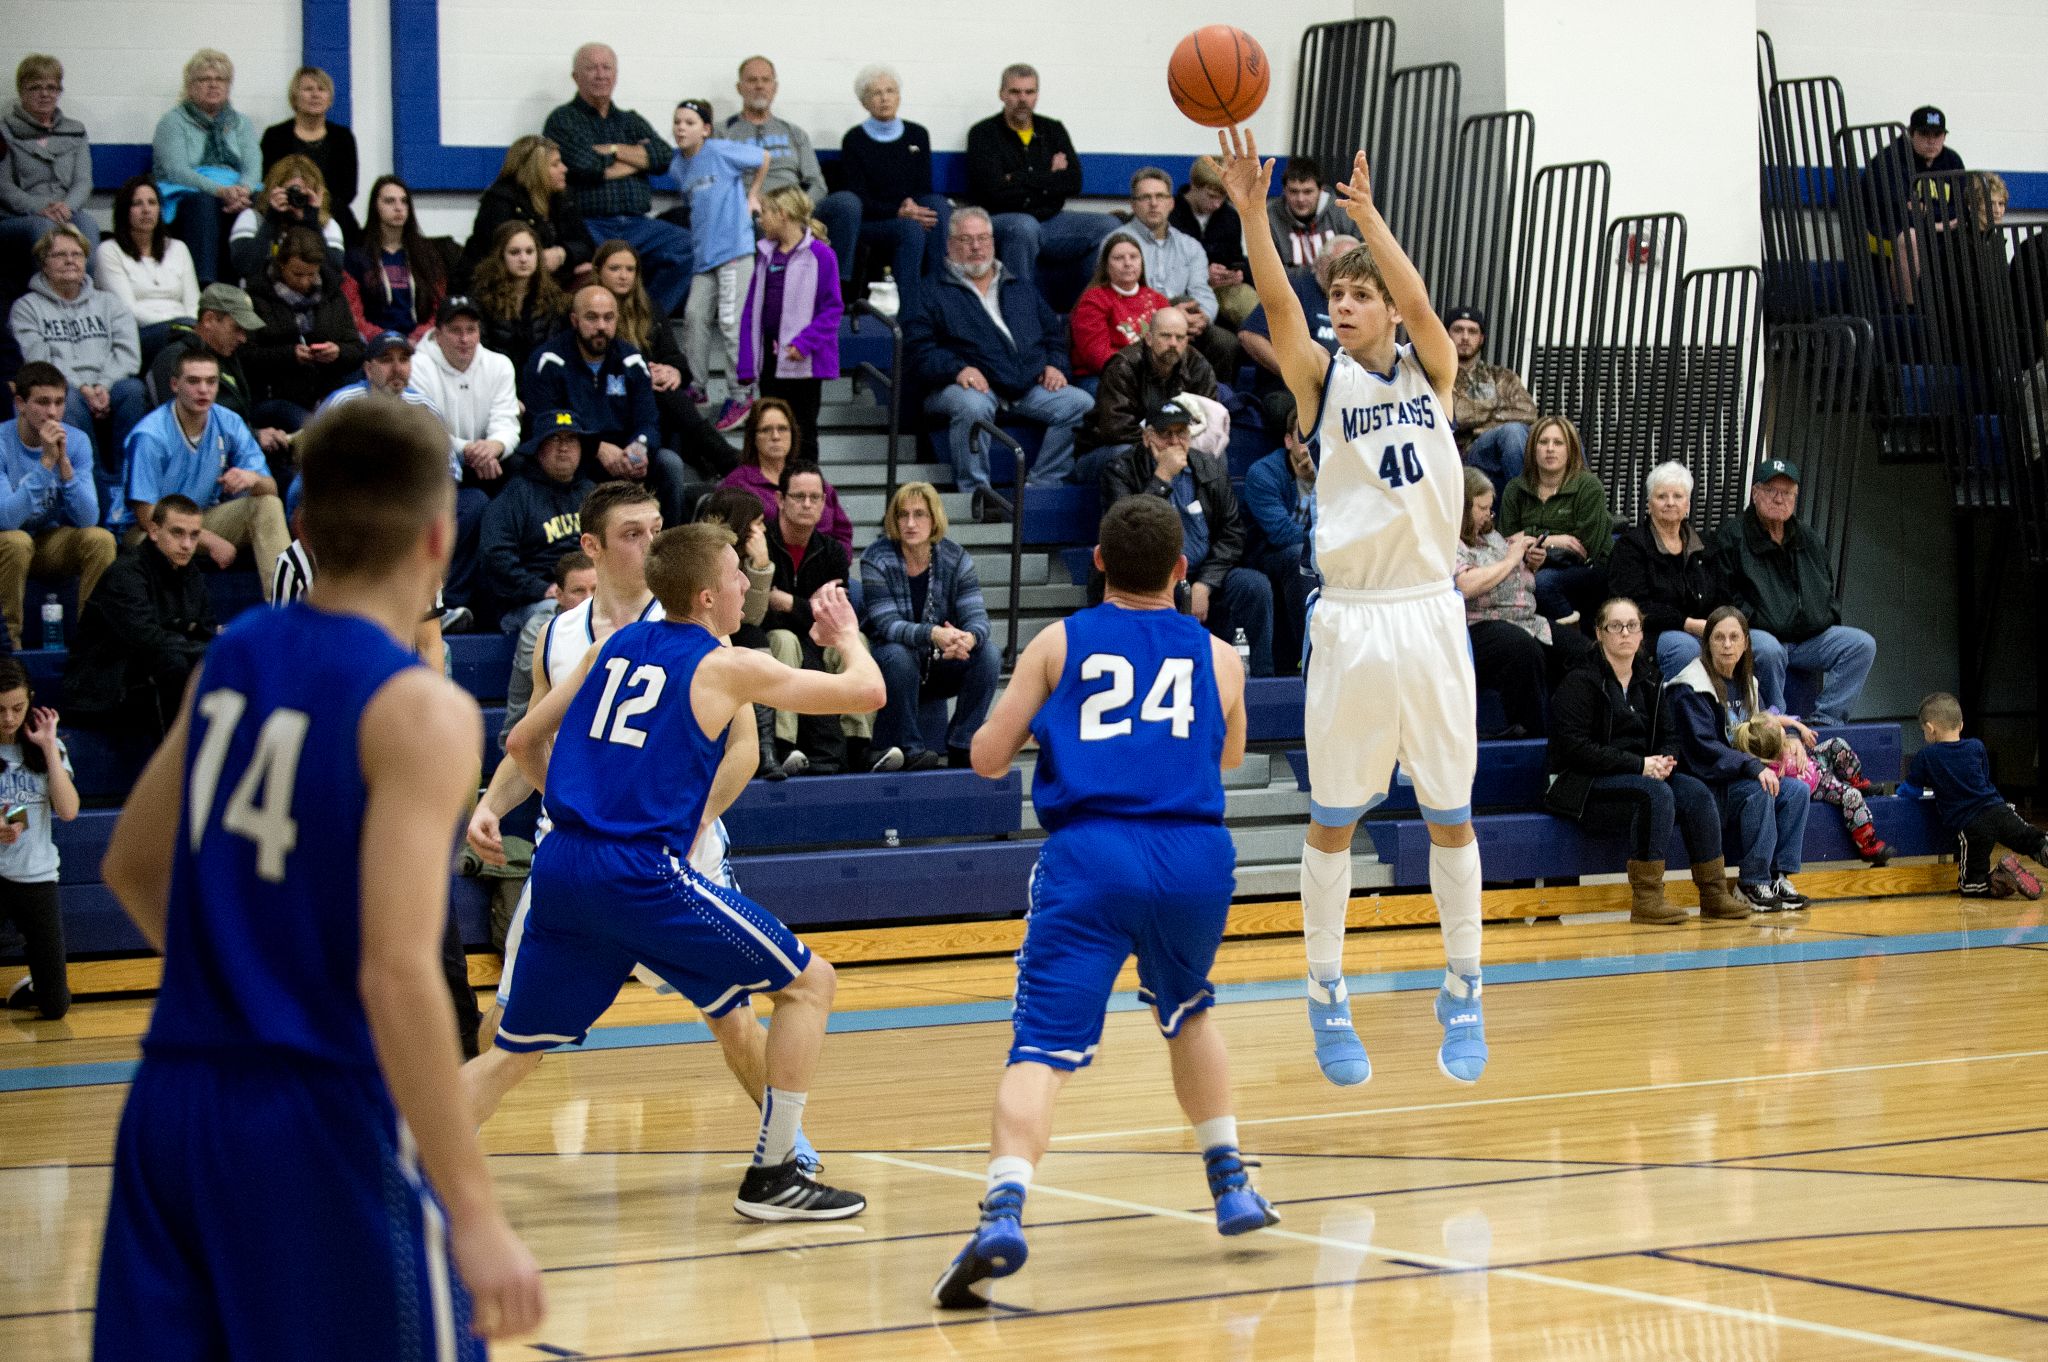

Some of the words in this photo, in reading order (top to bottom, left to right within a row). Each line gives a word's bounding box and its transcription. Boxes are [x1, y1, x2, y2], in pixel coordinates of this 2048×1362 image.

[606, 374, 627, 396] M
[1379, 442, 1424, 488] 40
[589, 657, 667, 748] 12
[1080, 653, 1195, 741] 24
[188, 688, 310, 883] 14
